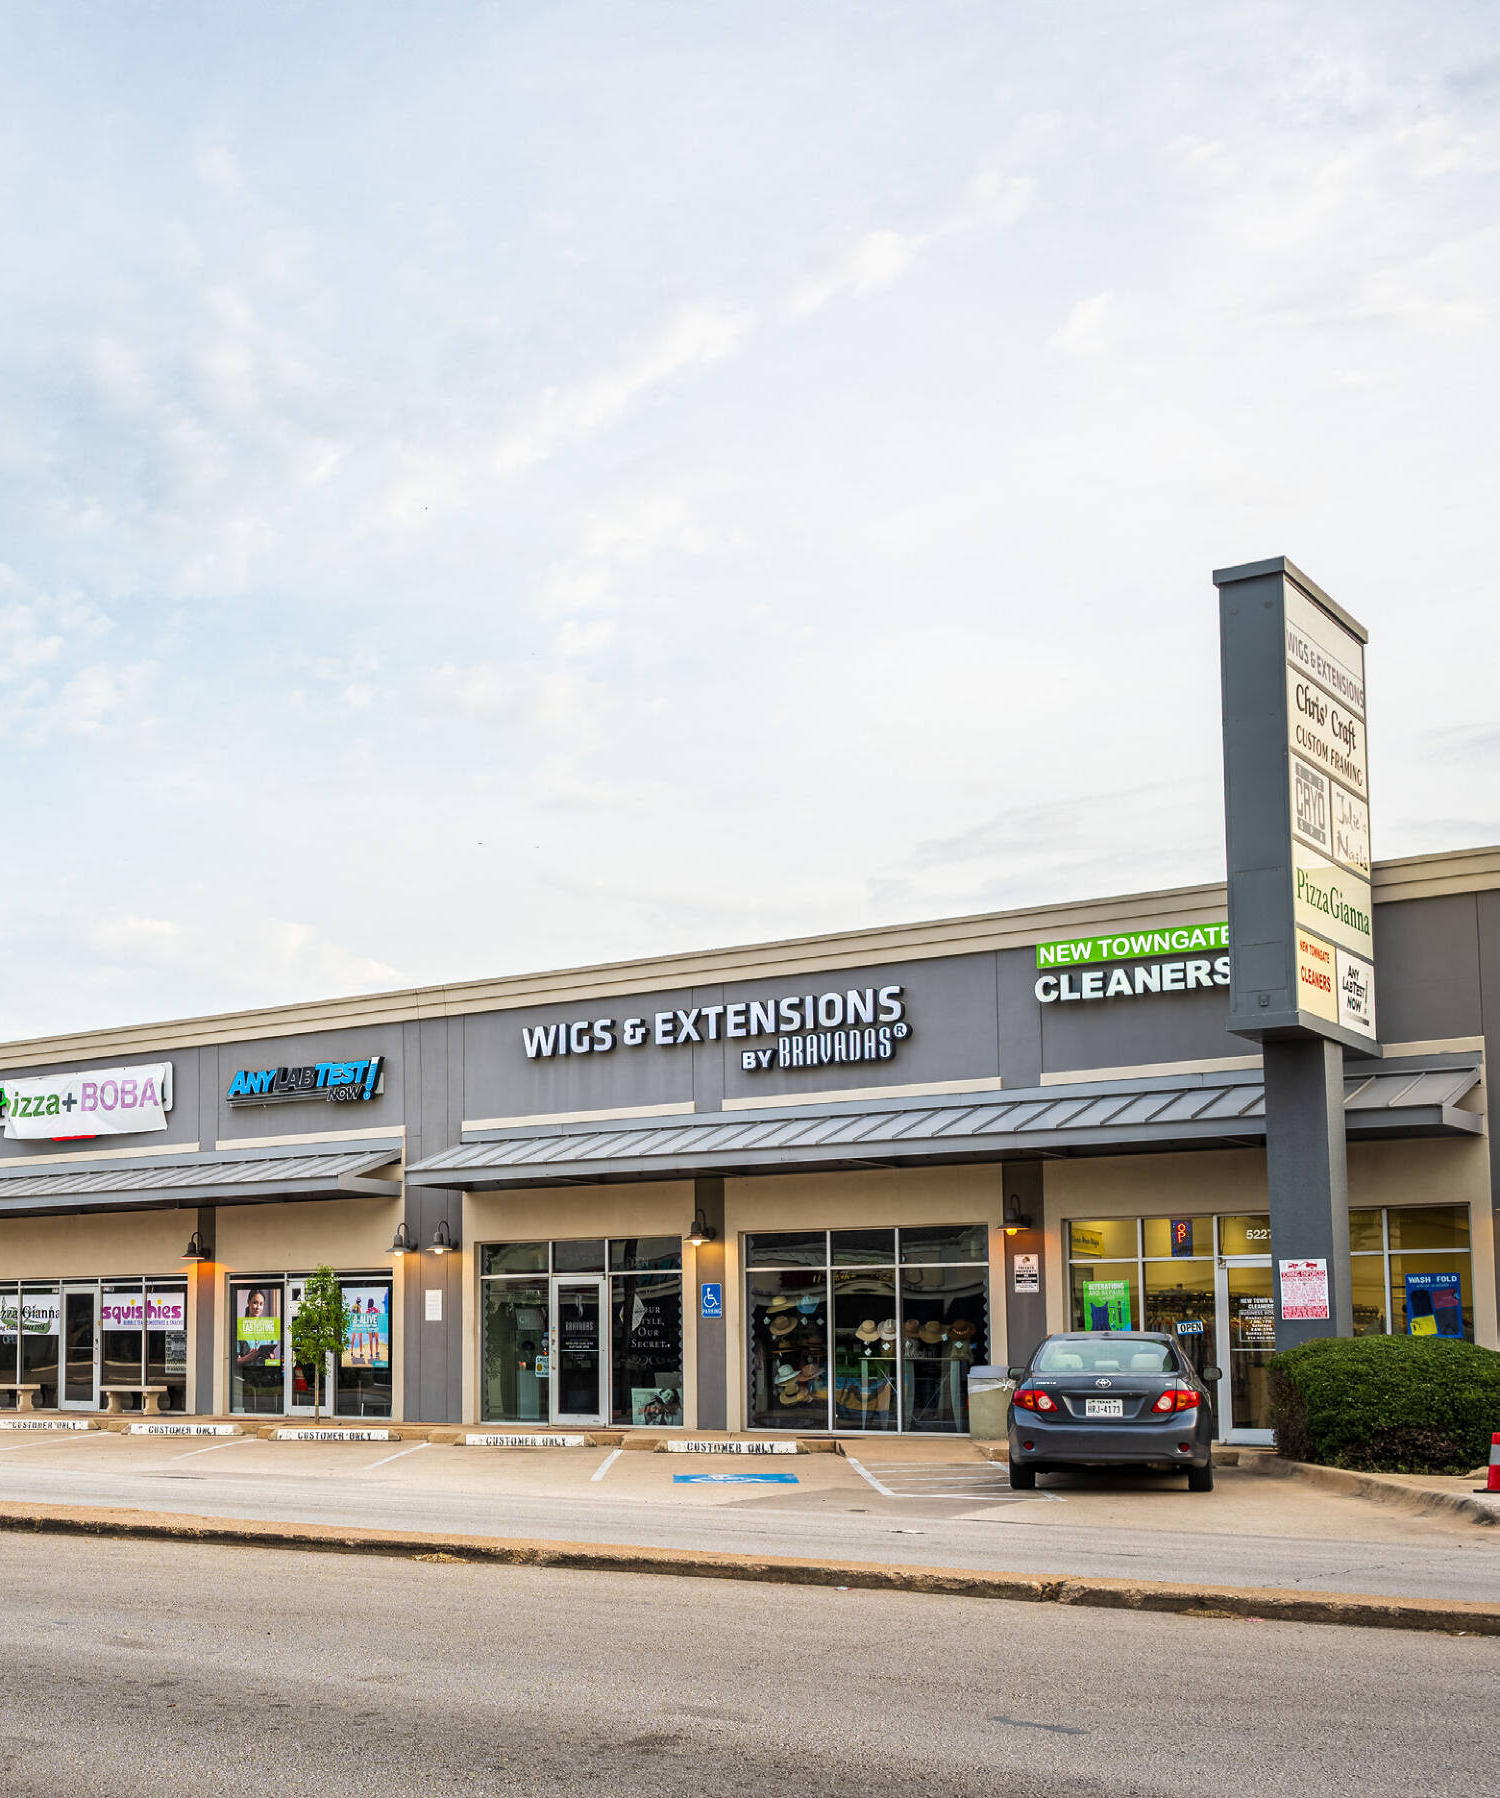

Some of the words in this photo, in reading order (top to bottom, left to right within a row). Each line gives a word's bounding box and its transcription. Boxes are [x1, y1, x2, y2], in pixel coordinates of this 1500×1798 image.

[1286, 629, 1309, 665] WIGS
[1310, 651, 1316, 668] &
[1317, 656, 1364, 708] EXTENSIONS
[1296, 684, 1327, 726] Chris'
[1331, 710, 1356, 757] Craft
[1296, 724, 1328, 762] CUSTOM
[1331, 749, 1363, 786] FRAMING
[1296, 777, 1325, 830] CRYO
[1040, 942, 1092, 965] NEW
[1097, 925, 1229, 957] TOWNGATE
[1300, 940, 1308, 953] NEW
[1310, 944, 1330, 964] TOWNGATE
[1034, 956, 1231, 1003] CLEANERS
[1301, 965, 1331, 992] CLEANERS
[1348, 965, 1359, 980] ANY
[1347, 995, 1362, 1012] NOW
[522, 1018, 614, 1058] WIGS
[623, 1018, 648, 1046] &
[655, 985, 902, 1046] EXTENSIONS
[741, 1049, 774, 1070] BY
[326, 1085, 364, 1101] NOW
[1409, 1276, 1431, 1284] WASH
[1436, 1275, 1457, 1283] FOLD
[102, 1299, 182, 1325] squishies
[1180, 1322, 1202, 1333] OPEN
[12, 1421, 53, 1430] CUSTOMER
[56, 1421, 76, 1430] ONLY
[148, 1425, 192, 1435] CUSTOMER
[196, 1425, 217, 1435] ONLY
[297, 1431, 345, 1440] CUSTOMER
[349, 1432, 372, 1441] ONLY
[485, 1436, 537, 1446] CUSTOMER
[542, 1436, 567, 1446] ONLY
[686, 1442, 743, 1453] CUSTOMER
[749, 1443, 775, 1453] ONLY
